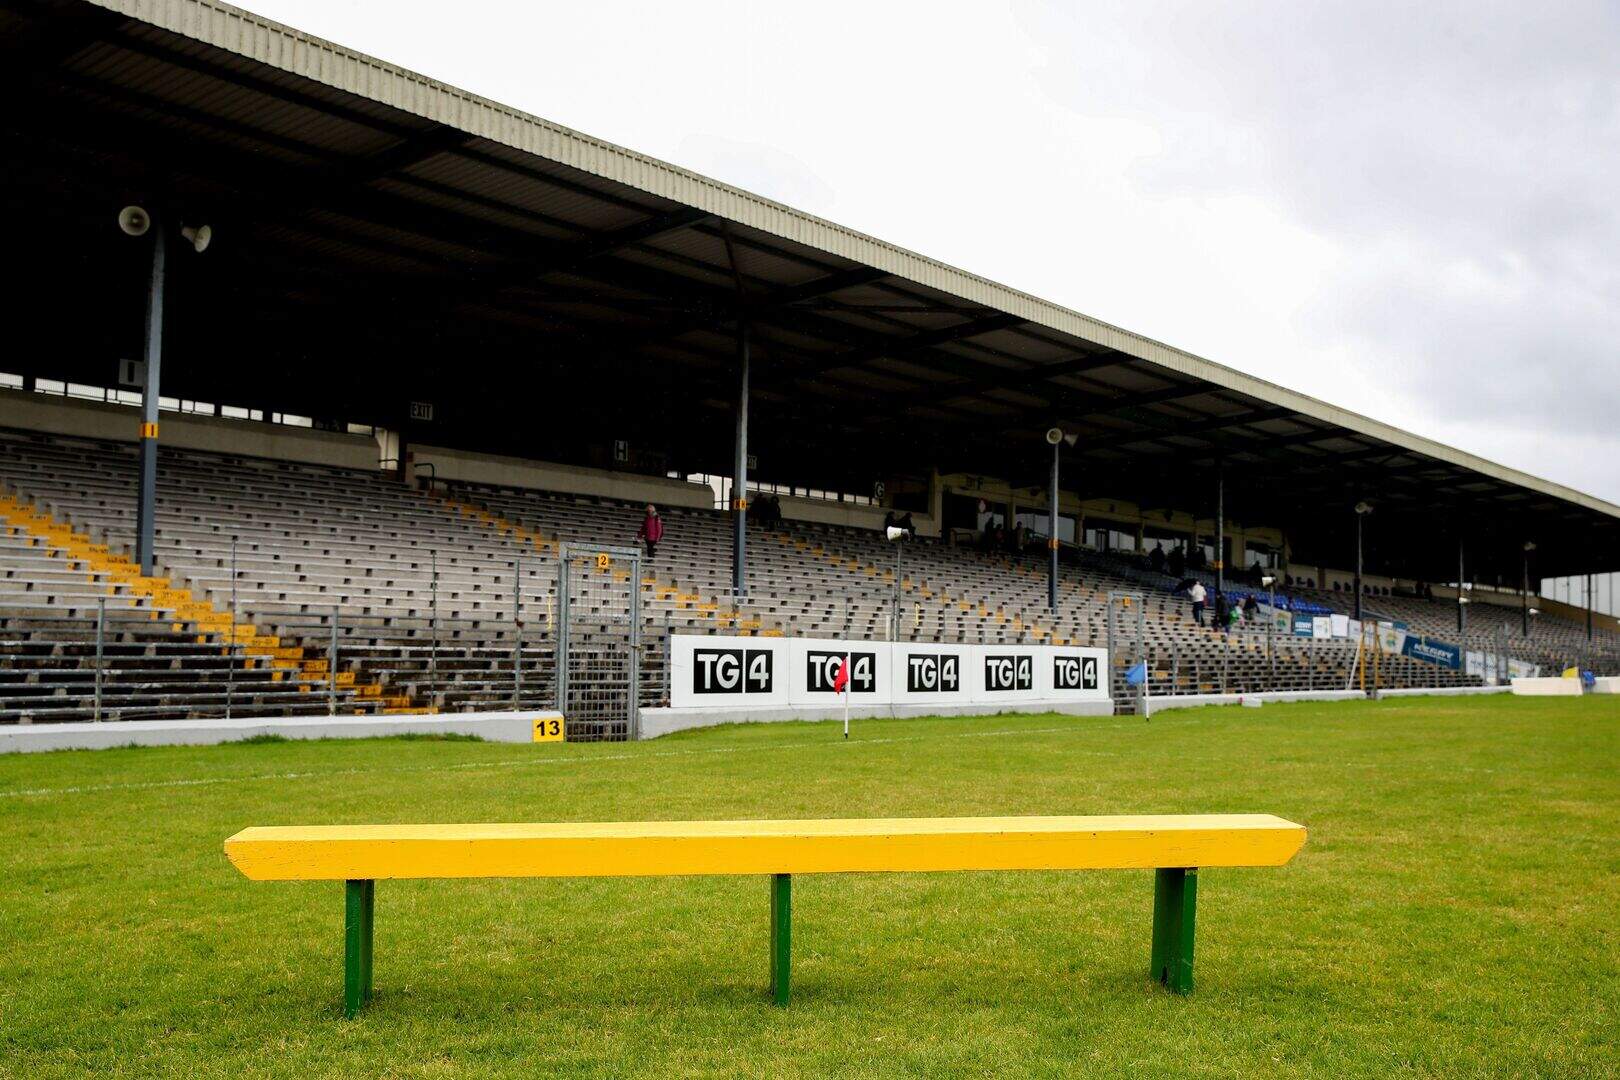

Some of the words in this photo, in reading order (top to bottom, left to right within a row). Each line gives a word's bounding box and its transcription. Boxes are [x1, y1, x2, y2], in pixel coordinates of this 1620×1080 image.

[412, 403, 431, 418] EXIT
[600, 555, 607, 566] 2
[697, 653, 769, 690] TG4
[909, 657, 957, 690] TG4
[986, 658, 1030, 688] TG4
[1054, 658, 1096, 687] TG4
[536, 720, 560, 736] 13
